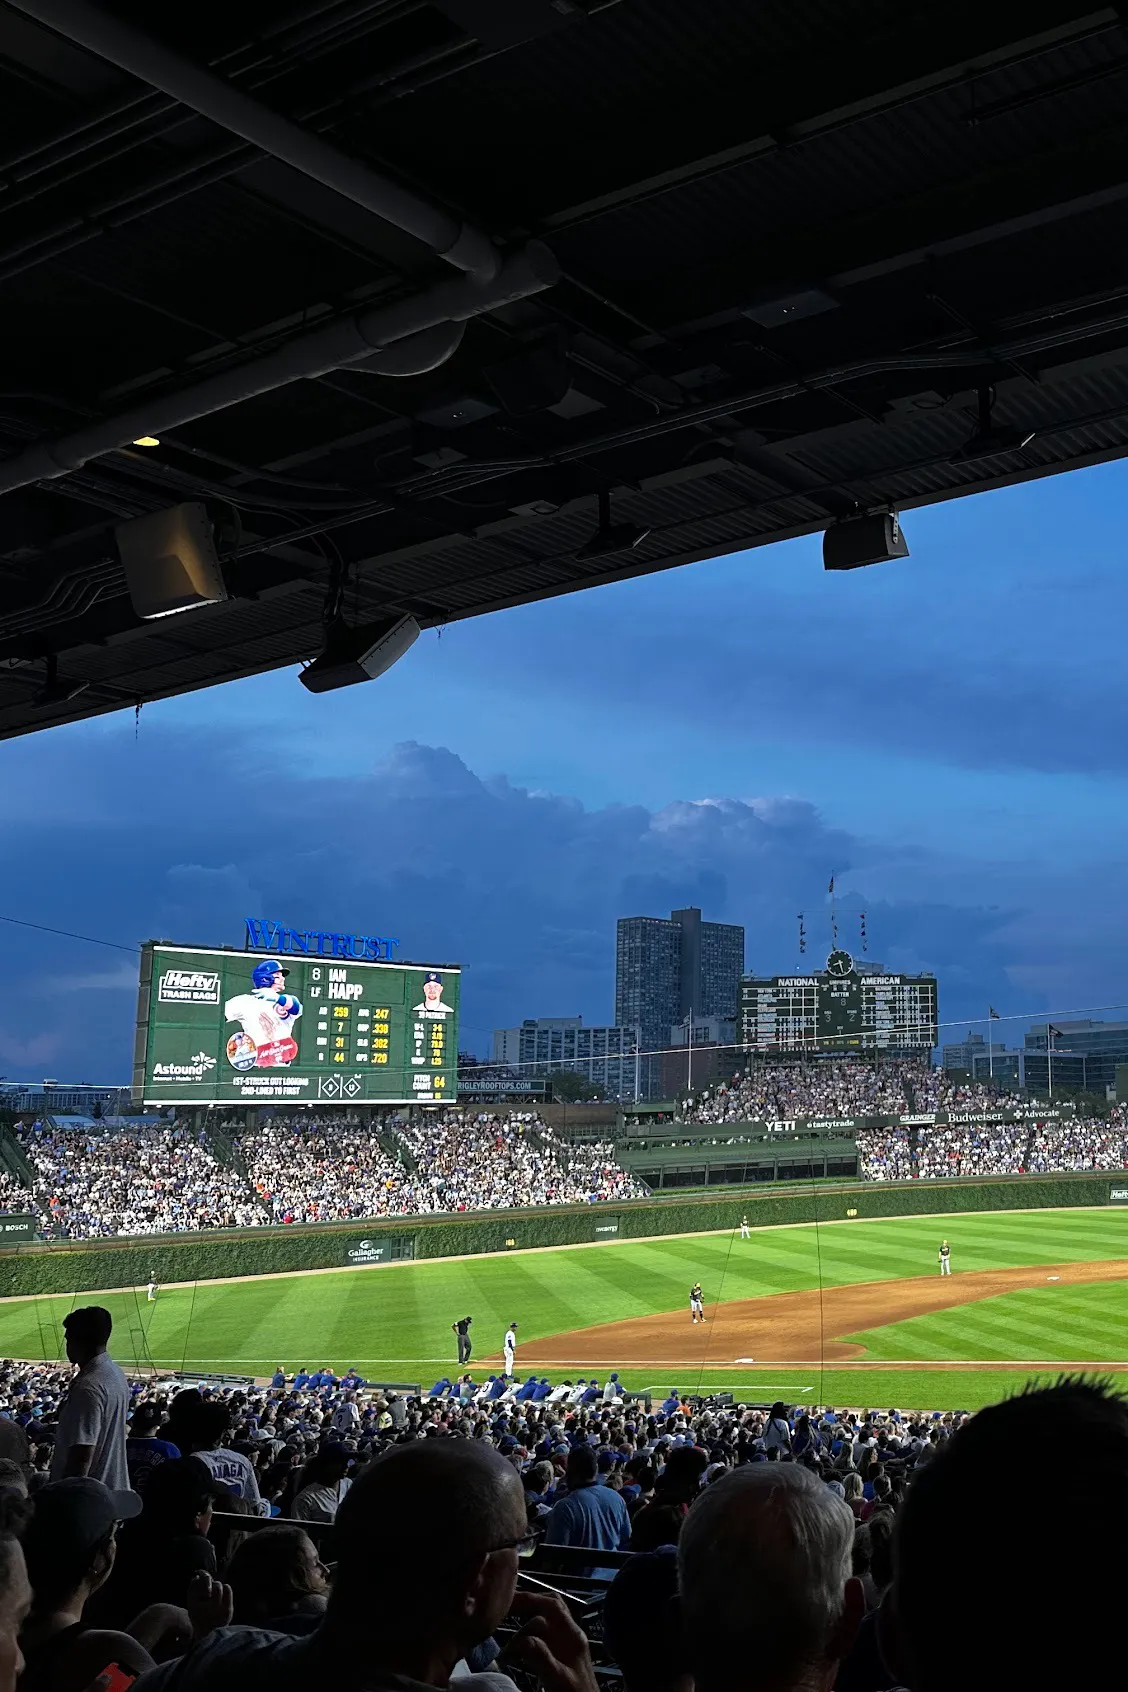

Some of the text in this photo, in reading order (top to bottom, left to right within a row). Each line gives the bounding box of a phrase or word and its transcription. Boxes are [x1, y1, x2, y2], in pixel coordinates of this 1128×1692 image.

[245, 917, 400, 961] WINTRUST
[312, 967, 321, 981] 8
[328, 968, 347, 983] IAN
[166, 971, 216, 989] Hefty
[778, 977, 820, 987] NATIONAL
[860, 976, 901, 985] AMERICAN
[162, 989, 217, 1001] TRASH BAGS
[310, 986, 322, 998] LF
[328, 982, 364, 1001] HAPP
[373, 1008, 390, 1020] .247
[338, 1021, 344, 1033] 7
[335, 1036, 345, 1048] 31
[334, 1052, 345, 1063] 44
[153, 1062, 203, 1075] Astound
[434, 1076, 445, 1088] 64
[457, 1080, 532, 1090] RIGLEYROOFTOPS.COM
[899, 1113, 936, 1122] GRAINGER
[948, 1112, 1003, 1123] Budweiser
[1024, 1109, 1060, 1119] Advocate
[765, 1121, 797, 1132] YETI
[813, 1119, 855, 1129] tastytrade
[5, 1223, 29, 1232] BOSCH
[348, 1247, 384, 1258] Gallagher
[352, 1254, 380, 1262] INSURANCE
